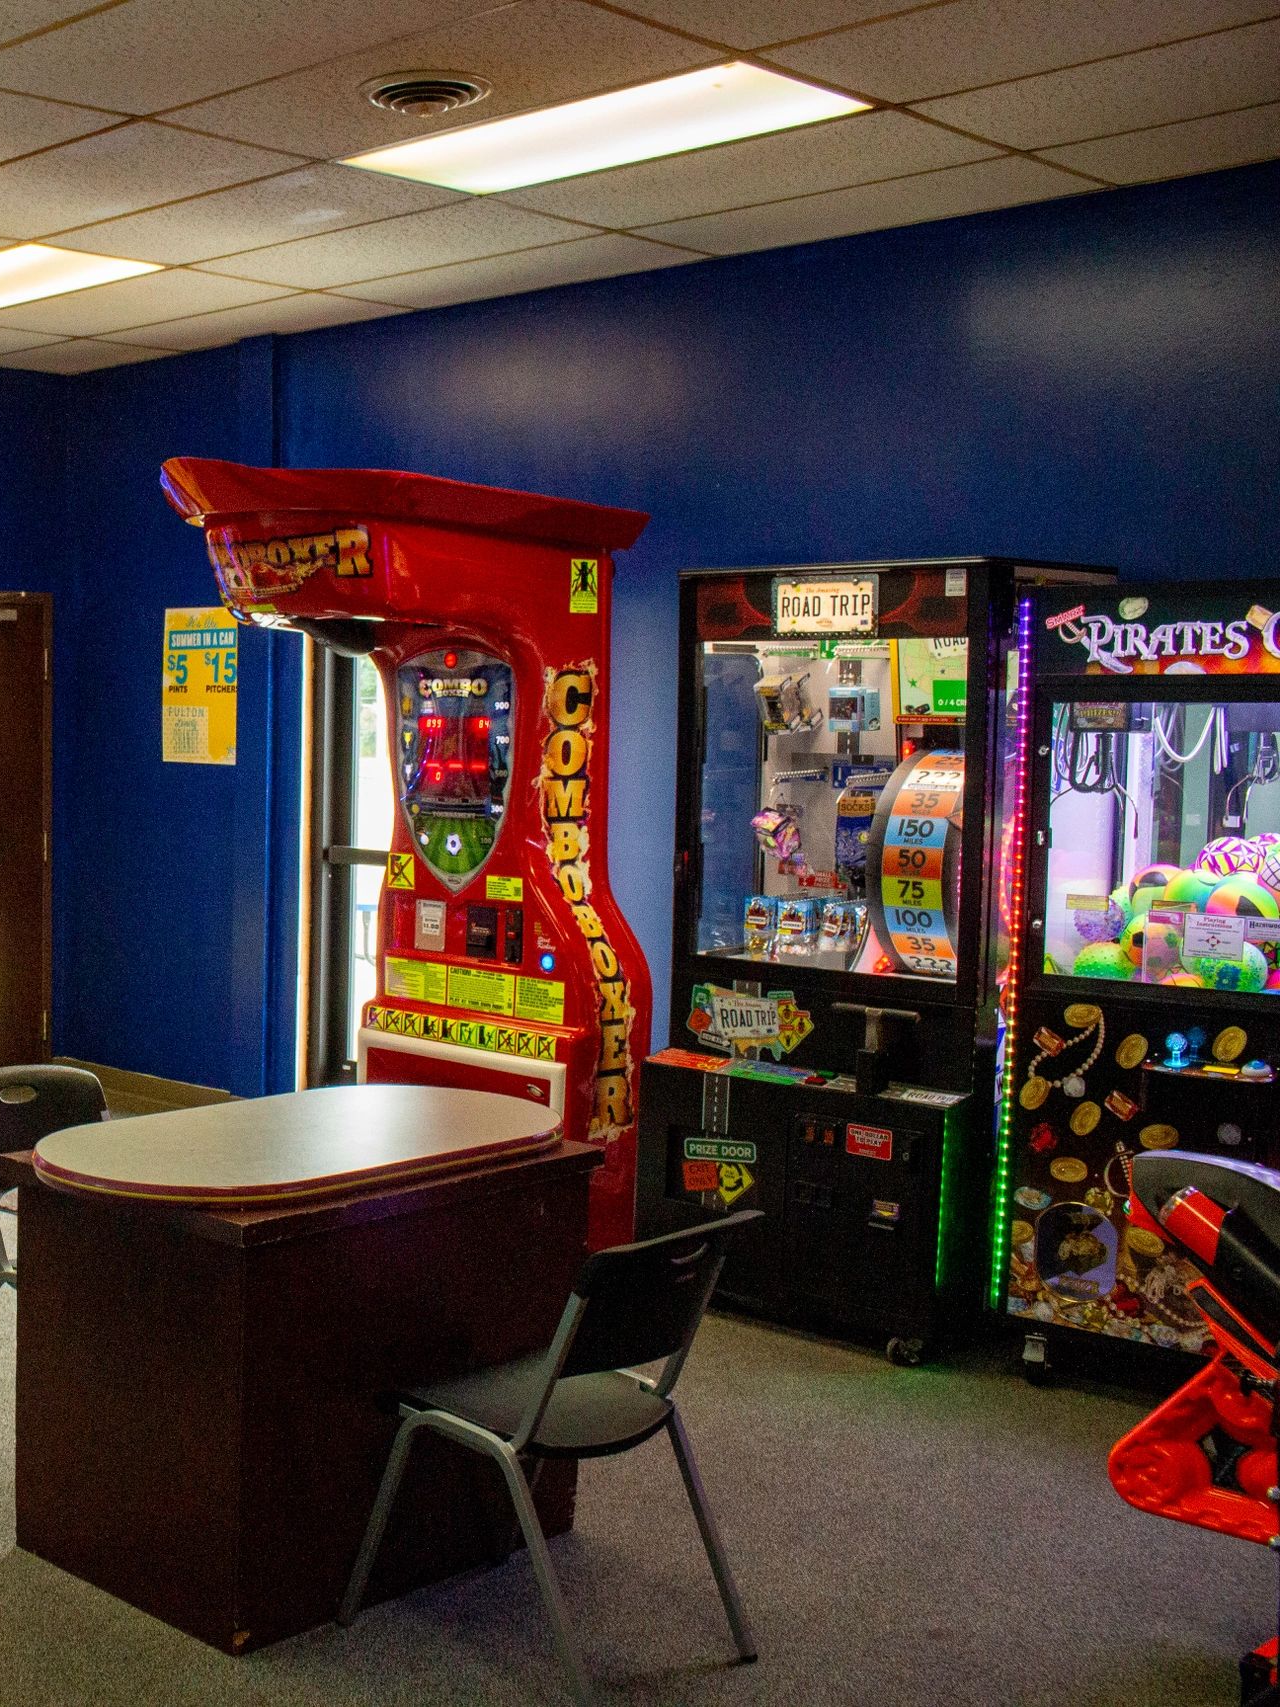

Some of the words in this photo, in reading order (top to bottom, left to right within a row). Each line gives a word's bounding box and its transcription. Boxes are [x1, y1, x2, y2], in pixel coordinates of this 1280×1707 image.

[781, 596, 820, 618] ROAD
[830, 594, 870, 616] TRIP
[1045, 604, 1086, 630] SMART
[171, 633, 201, 647] SUMMER
[203, 632, 210, 646] IN
[212, 632, 218, 645] A
[219, 631, 234, 645] CAN
[1080, 614, 1250, 663] PIRATES
[167, 654, 188, 684] $5
[204, 652, 236, 684] $15
[169, 685, 188, 694] PINTS
[419, 678, 488, 697] COMBO
[168, 706, 205, 717] FULTON
[494, 702, 509, 710] 900
[426, 719, 442, 728] 899
[495, 736, 509, 744] 700
[841, 801, 870, 812] SOCKS
[911, 792, 940, 808] 35
[490, 805, 504, 813] 300
[898, 818, 935, 838] 150
[898, 849, 926, 869] 50
[897, 880, 925, 899] 75
[895, 909, 932, 928] 100
[1196, 921, 1233, 929] Instructions
[1203, 916, 1226, 924] Playing
[906, 936, 936, 951] 35
[720, 1008, 753, 1029] ROAD
[755, 1010, 777, 1027] TRIP
[689, 1143, 718, 1155] PRIZE
[722, 1146, 752, 1158] DOOR
